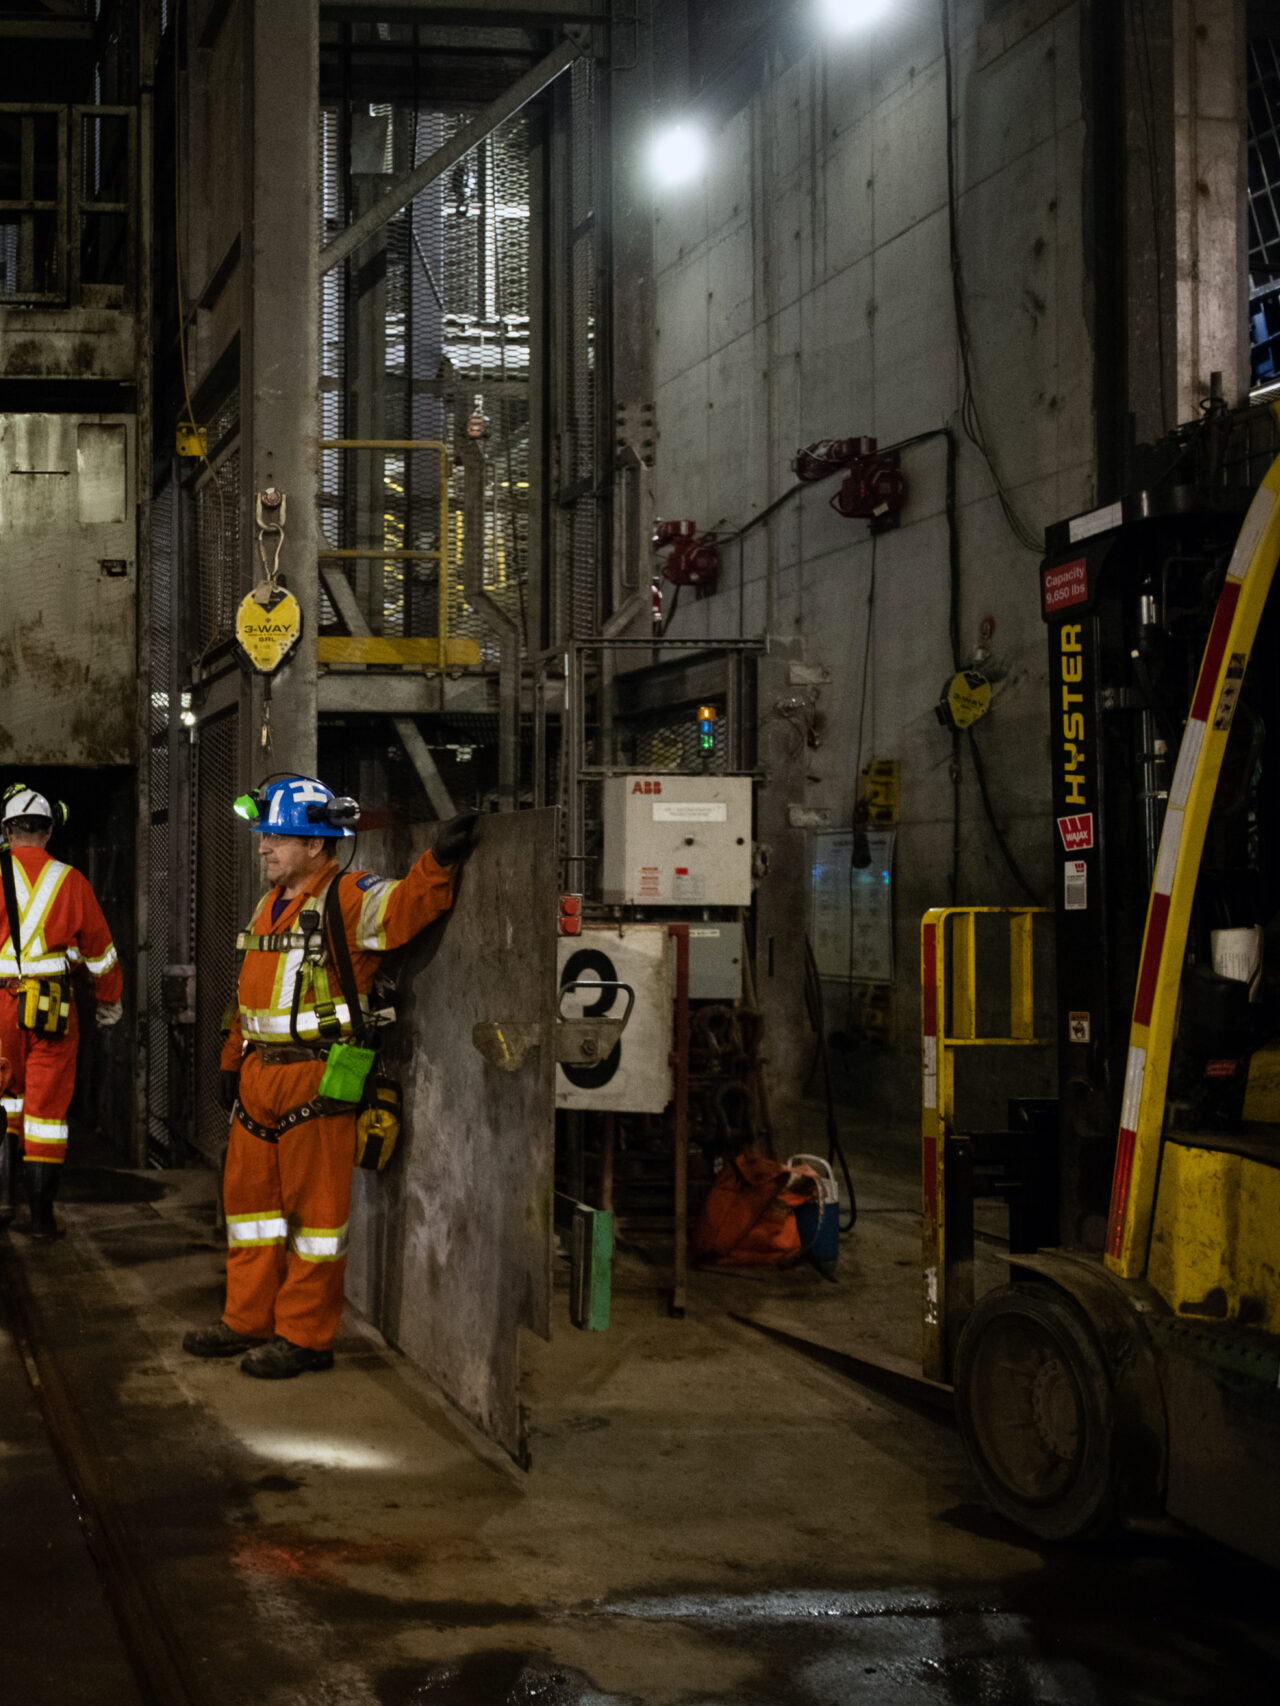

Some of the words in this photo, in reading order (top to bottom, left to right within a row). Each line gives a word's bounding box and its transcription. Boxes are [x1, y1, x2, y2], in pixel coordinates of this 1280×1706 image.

[1045, 567, 1085, 588] Capacity
[1046, 586, 1070, 604] 9,650
[1071, 583, 1086, 596] lbs
[244, 624, 291, 633] 3-WAY
[1060, 623, 1087, 805] HYSTER
[631, 781, 662, 795] ABB
[1065, 829, 1089, 842] WAJAX
